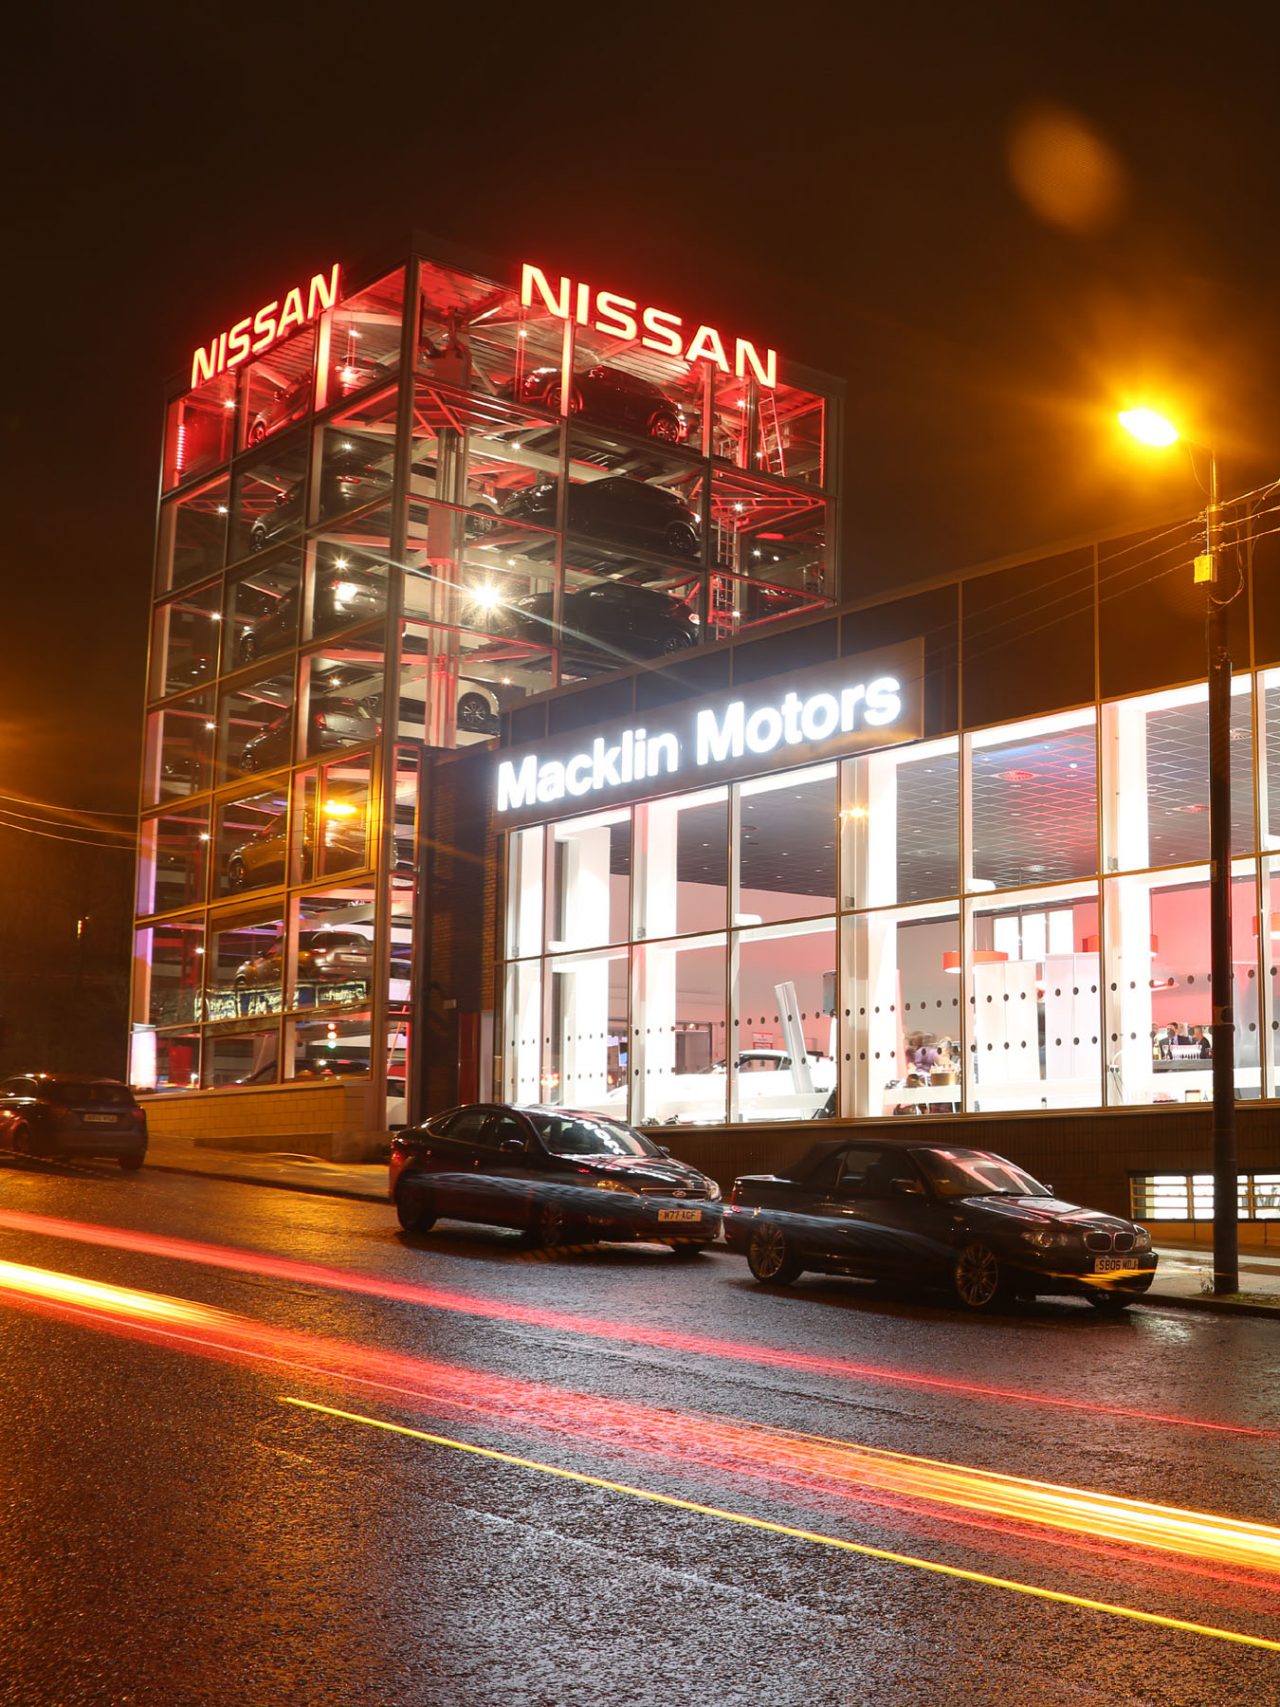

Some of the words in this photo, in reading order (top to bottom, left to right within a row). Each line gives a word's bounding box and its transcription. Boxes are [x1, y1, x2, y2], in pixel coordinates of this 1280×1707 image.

[191, 263, 342, 387] NISSAN
[520, 263, 777, 388] NISSAN
[497, 728, 680, 811] Macklin
[696, 677, 902, 766] Motors
